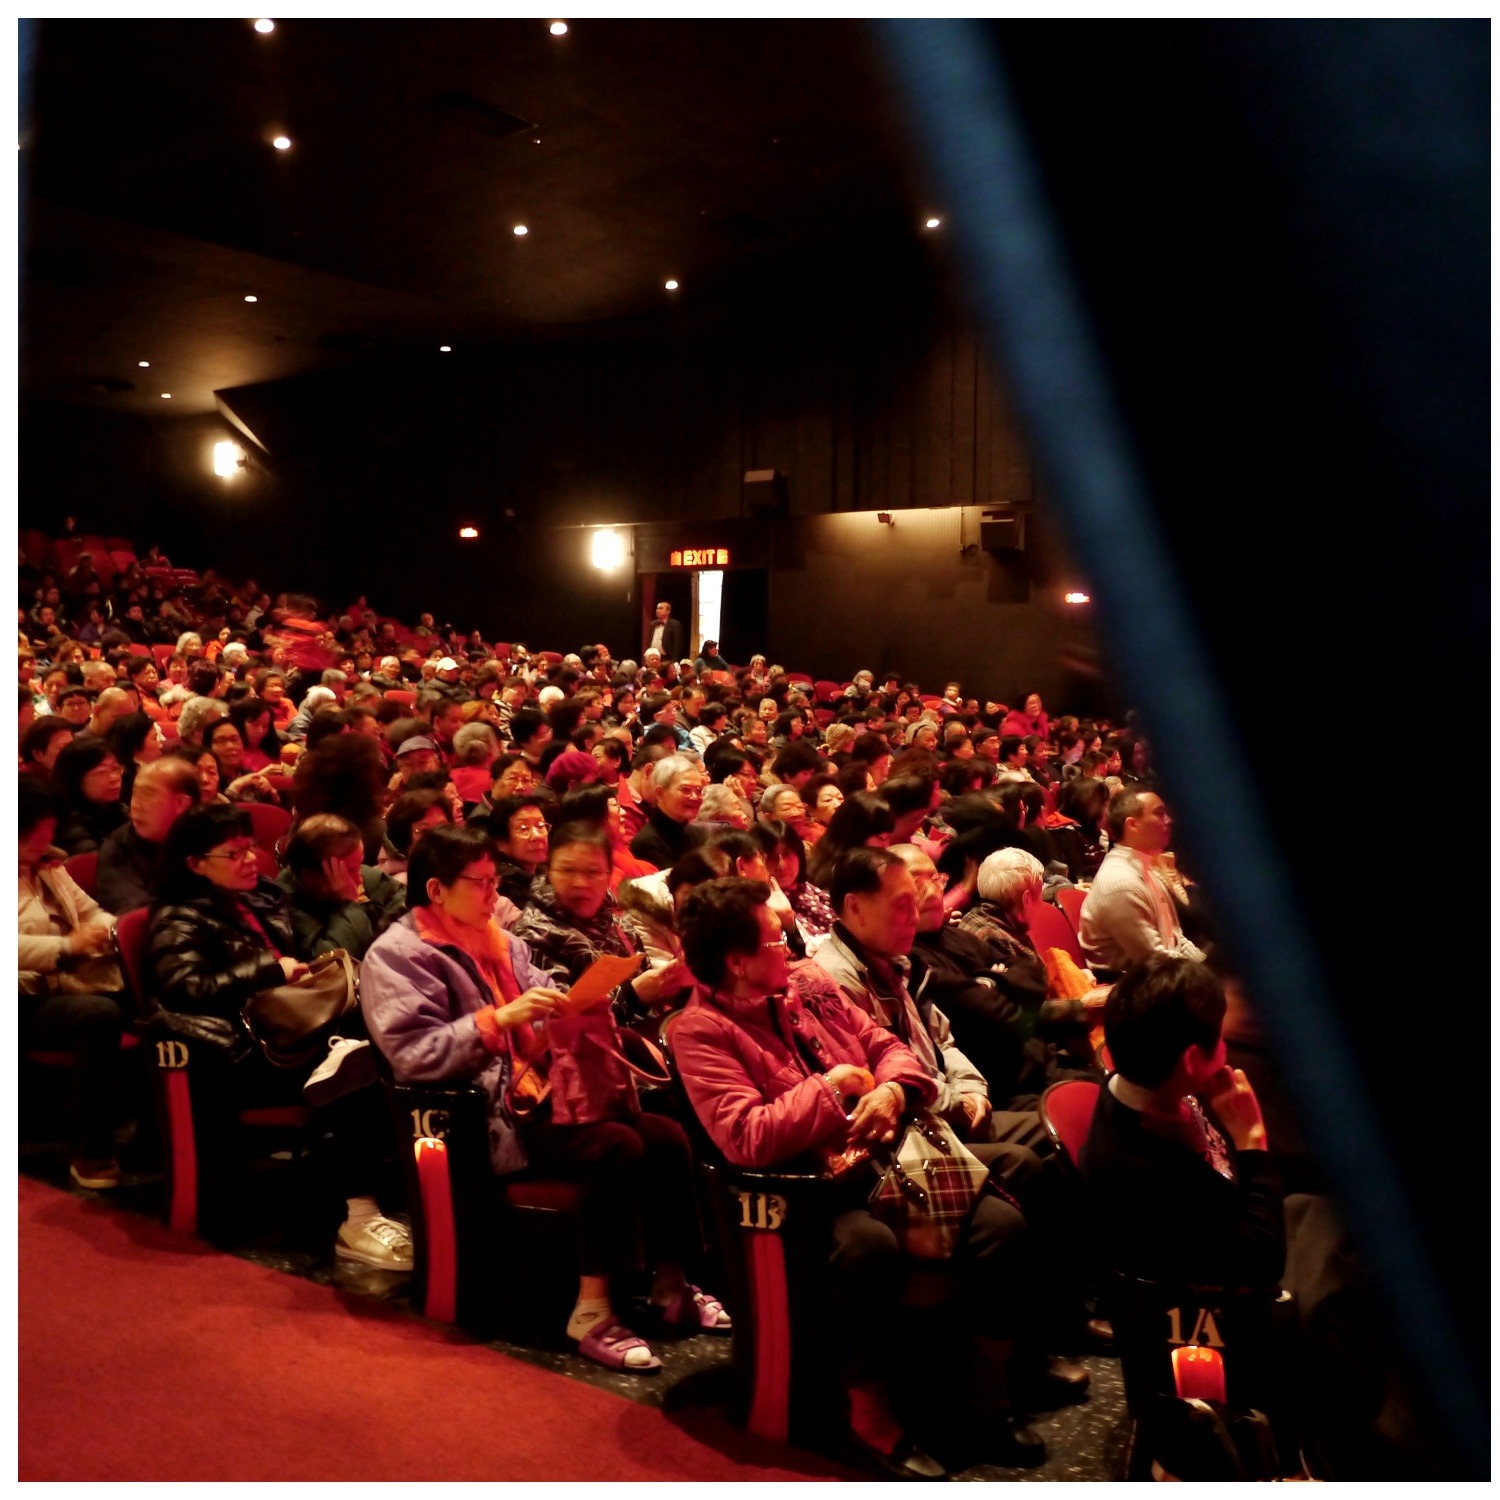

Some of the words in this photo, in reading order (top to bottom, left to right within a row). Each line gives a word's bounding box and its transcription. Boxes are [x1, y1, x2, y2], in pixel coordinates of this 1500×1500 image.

[683, 549, 716, 566] EXIT
[156, 1040, 190, 1068] 1D
[410, 1109, 449, 1138] 1C
[737, 1191, 787, 1230] 1B
[1165, 1307, 1225, 1347] 1A
